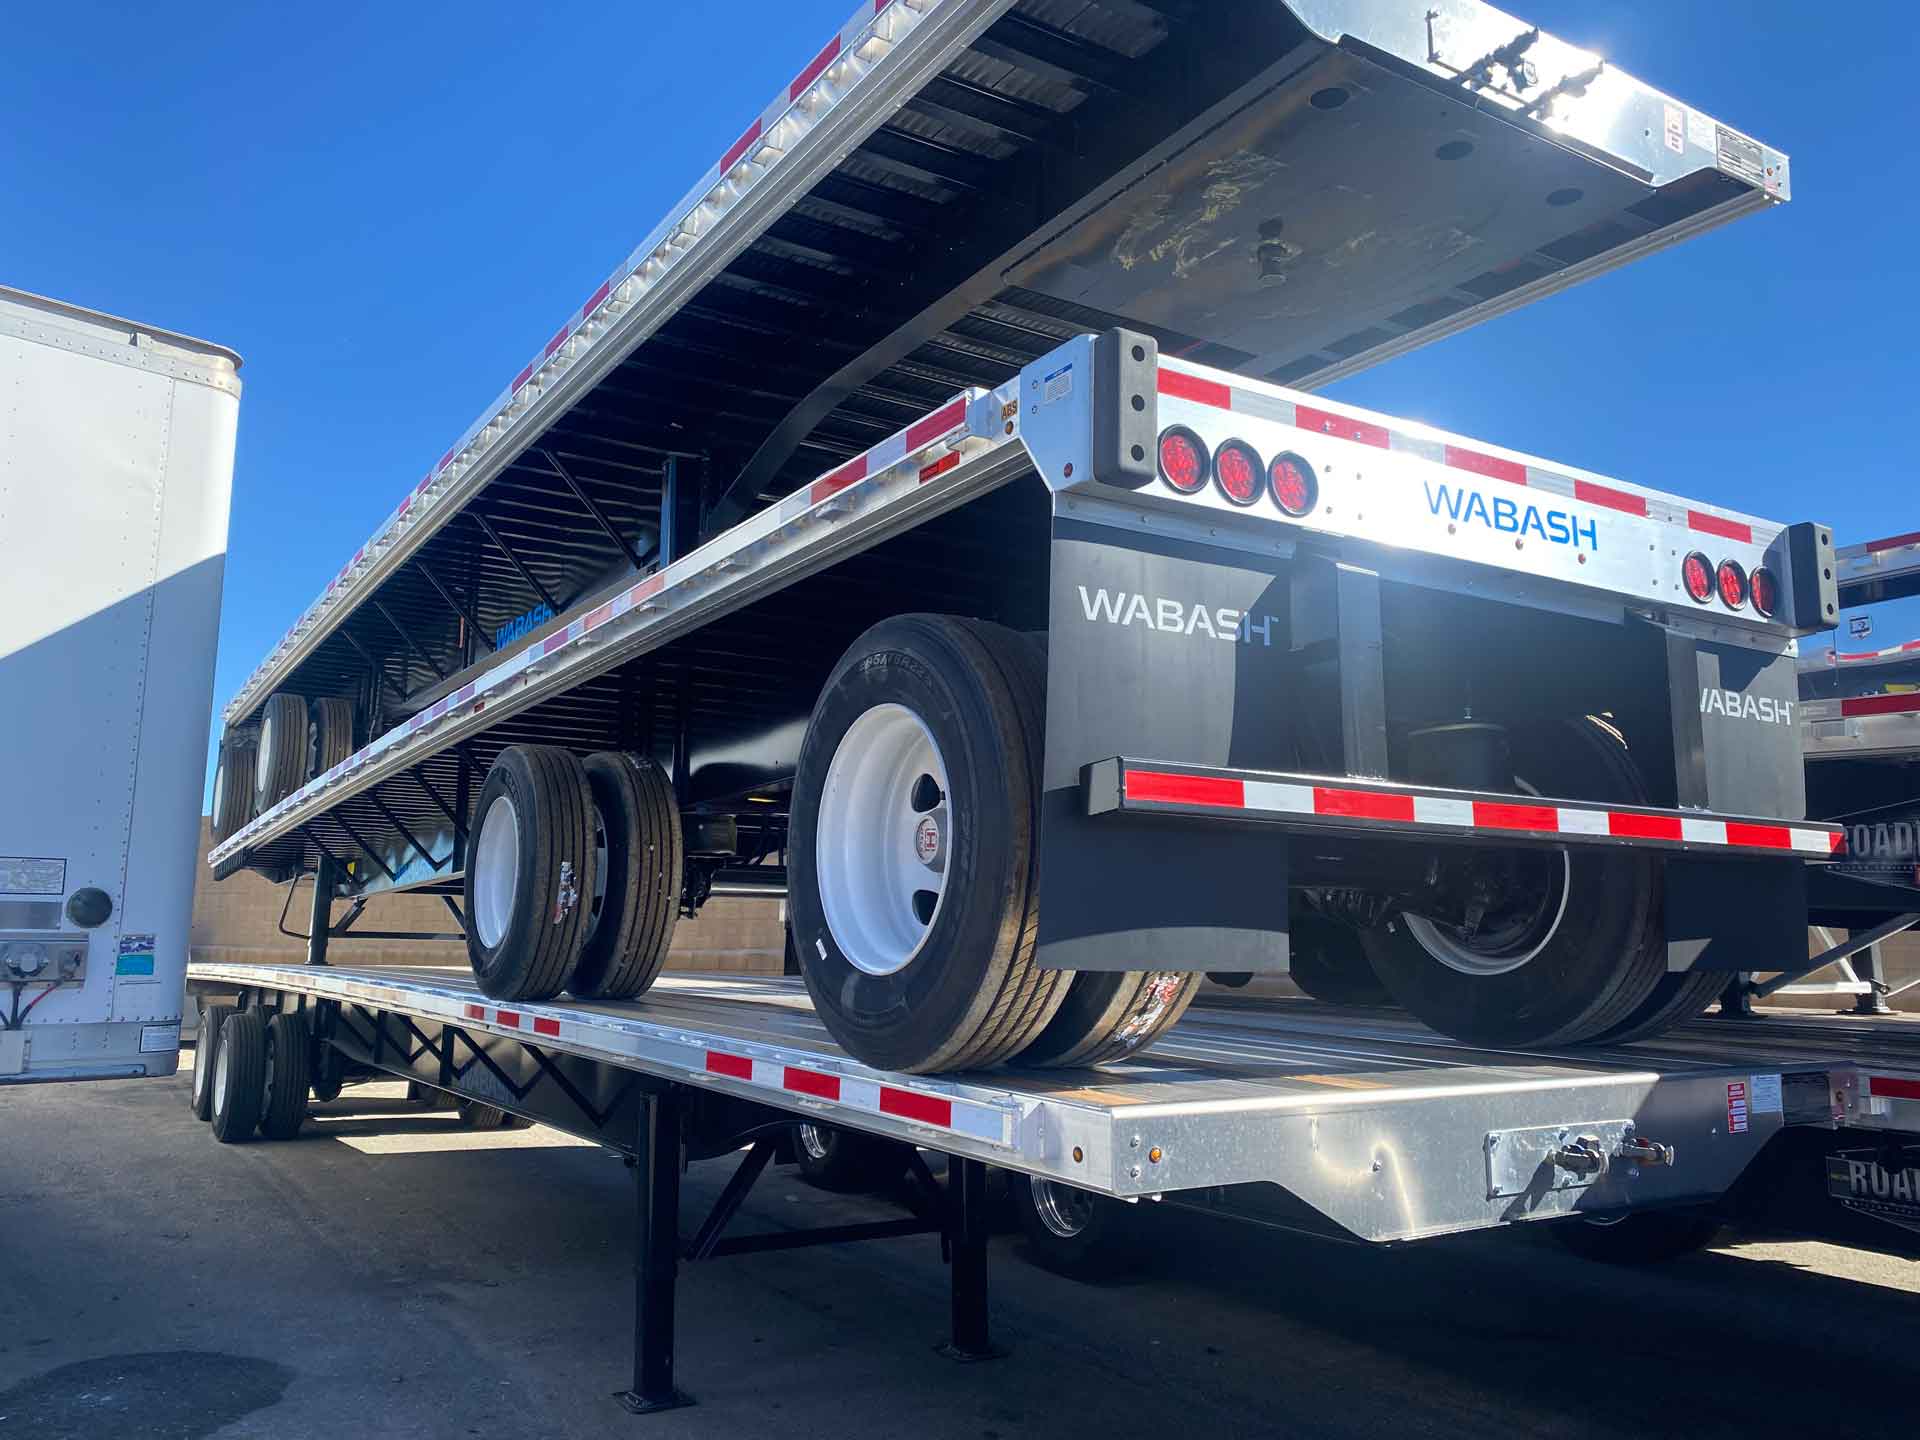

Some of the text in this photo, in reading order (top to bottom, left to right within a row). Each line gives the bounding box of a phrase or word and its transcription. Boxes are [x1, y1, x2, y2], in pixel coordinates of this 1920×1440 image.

[1001, 398, 1018, 420] ABS
[1424, 480, 1598, 551] WABASH
[1078, 585, 1272, 646] WABASH
